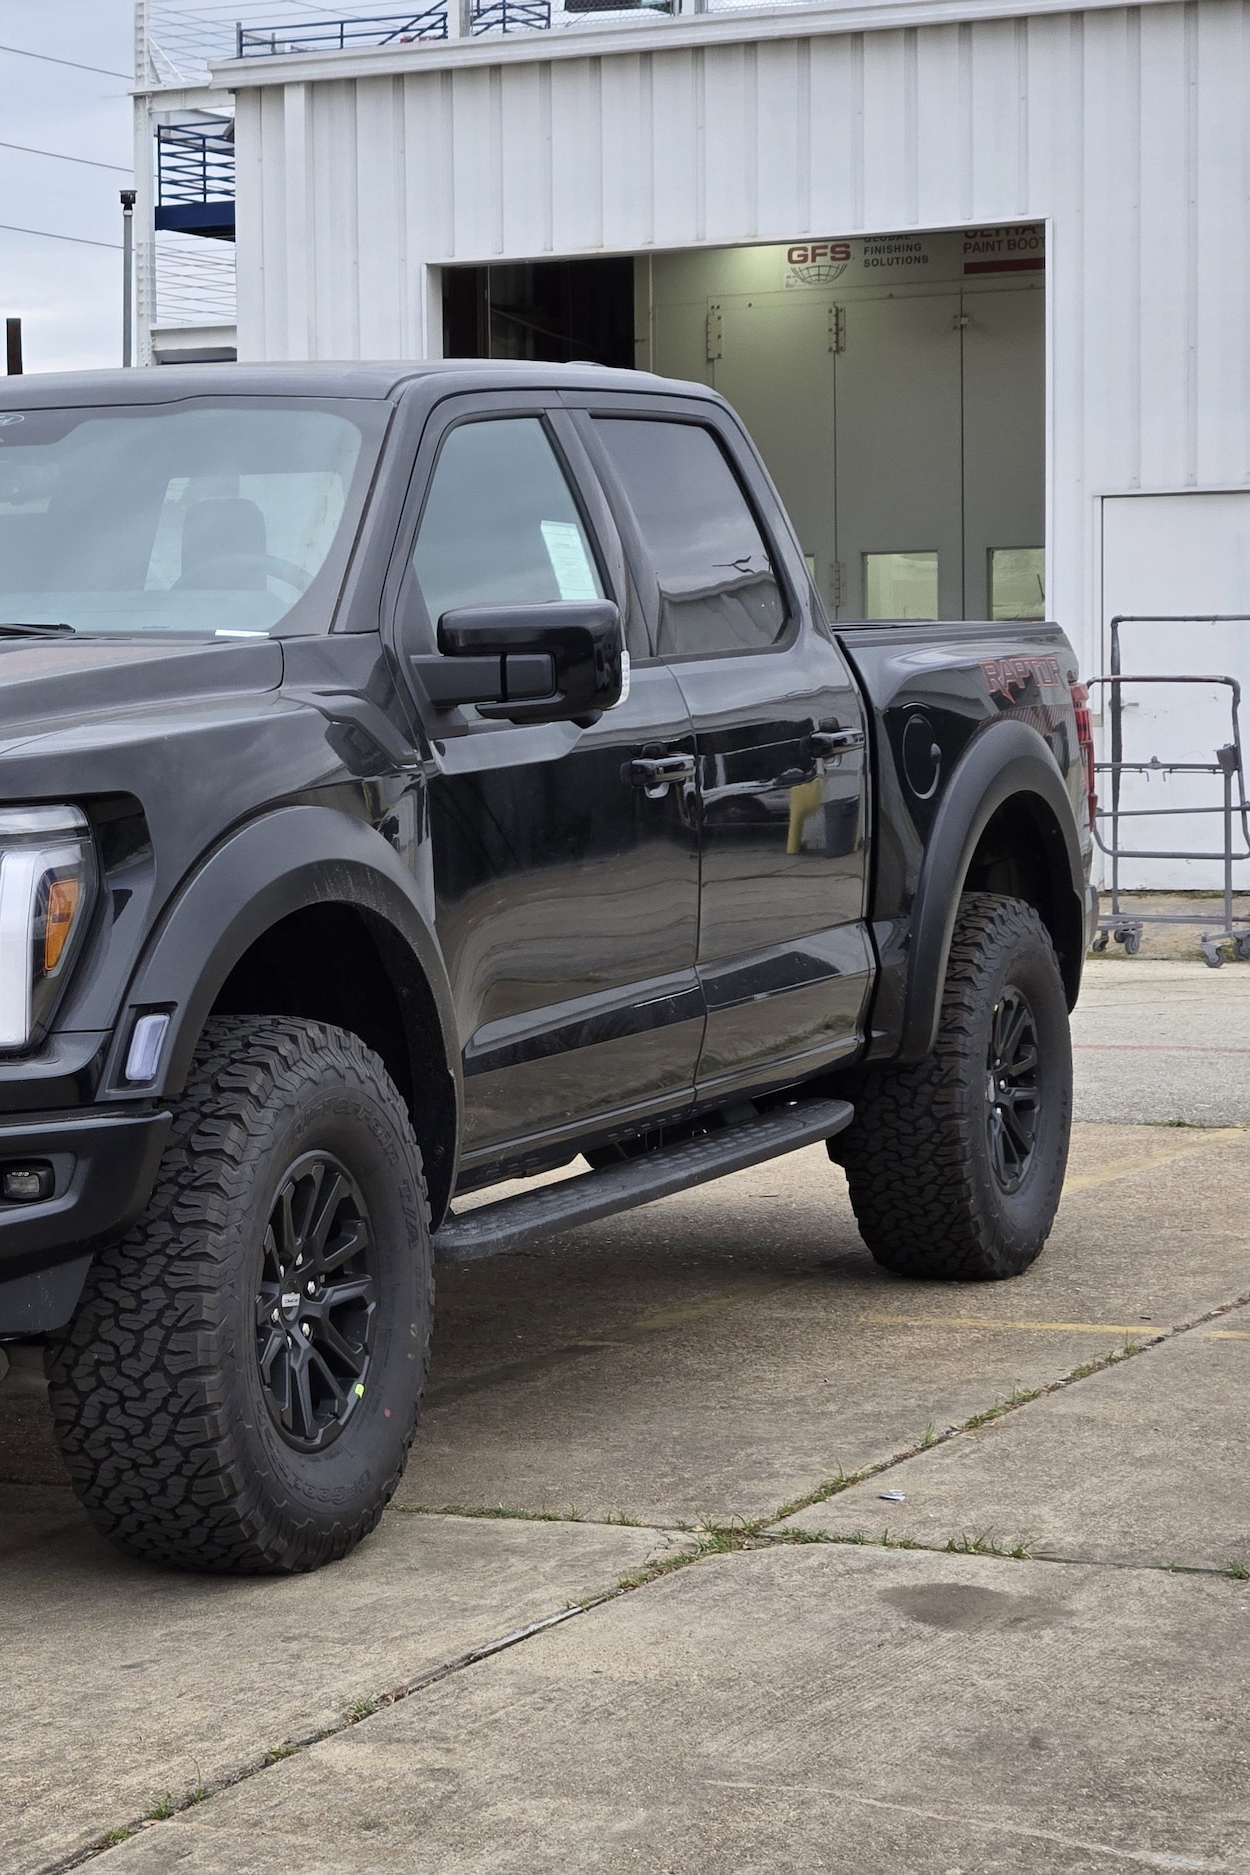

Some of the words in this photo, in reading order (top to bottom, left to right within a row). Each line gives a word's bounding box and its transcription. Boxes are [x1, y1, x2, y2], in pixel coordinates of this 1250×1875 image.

[787, 243, 851, 265] GFS
[864, 243, 922, 255] FINISHING
[963, 240, 1004, 254] PAINT
[864, 255, 929, 268] SOLUTIONS
[978, 656, 1070, 705] RAPTOR
